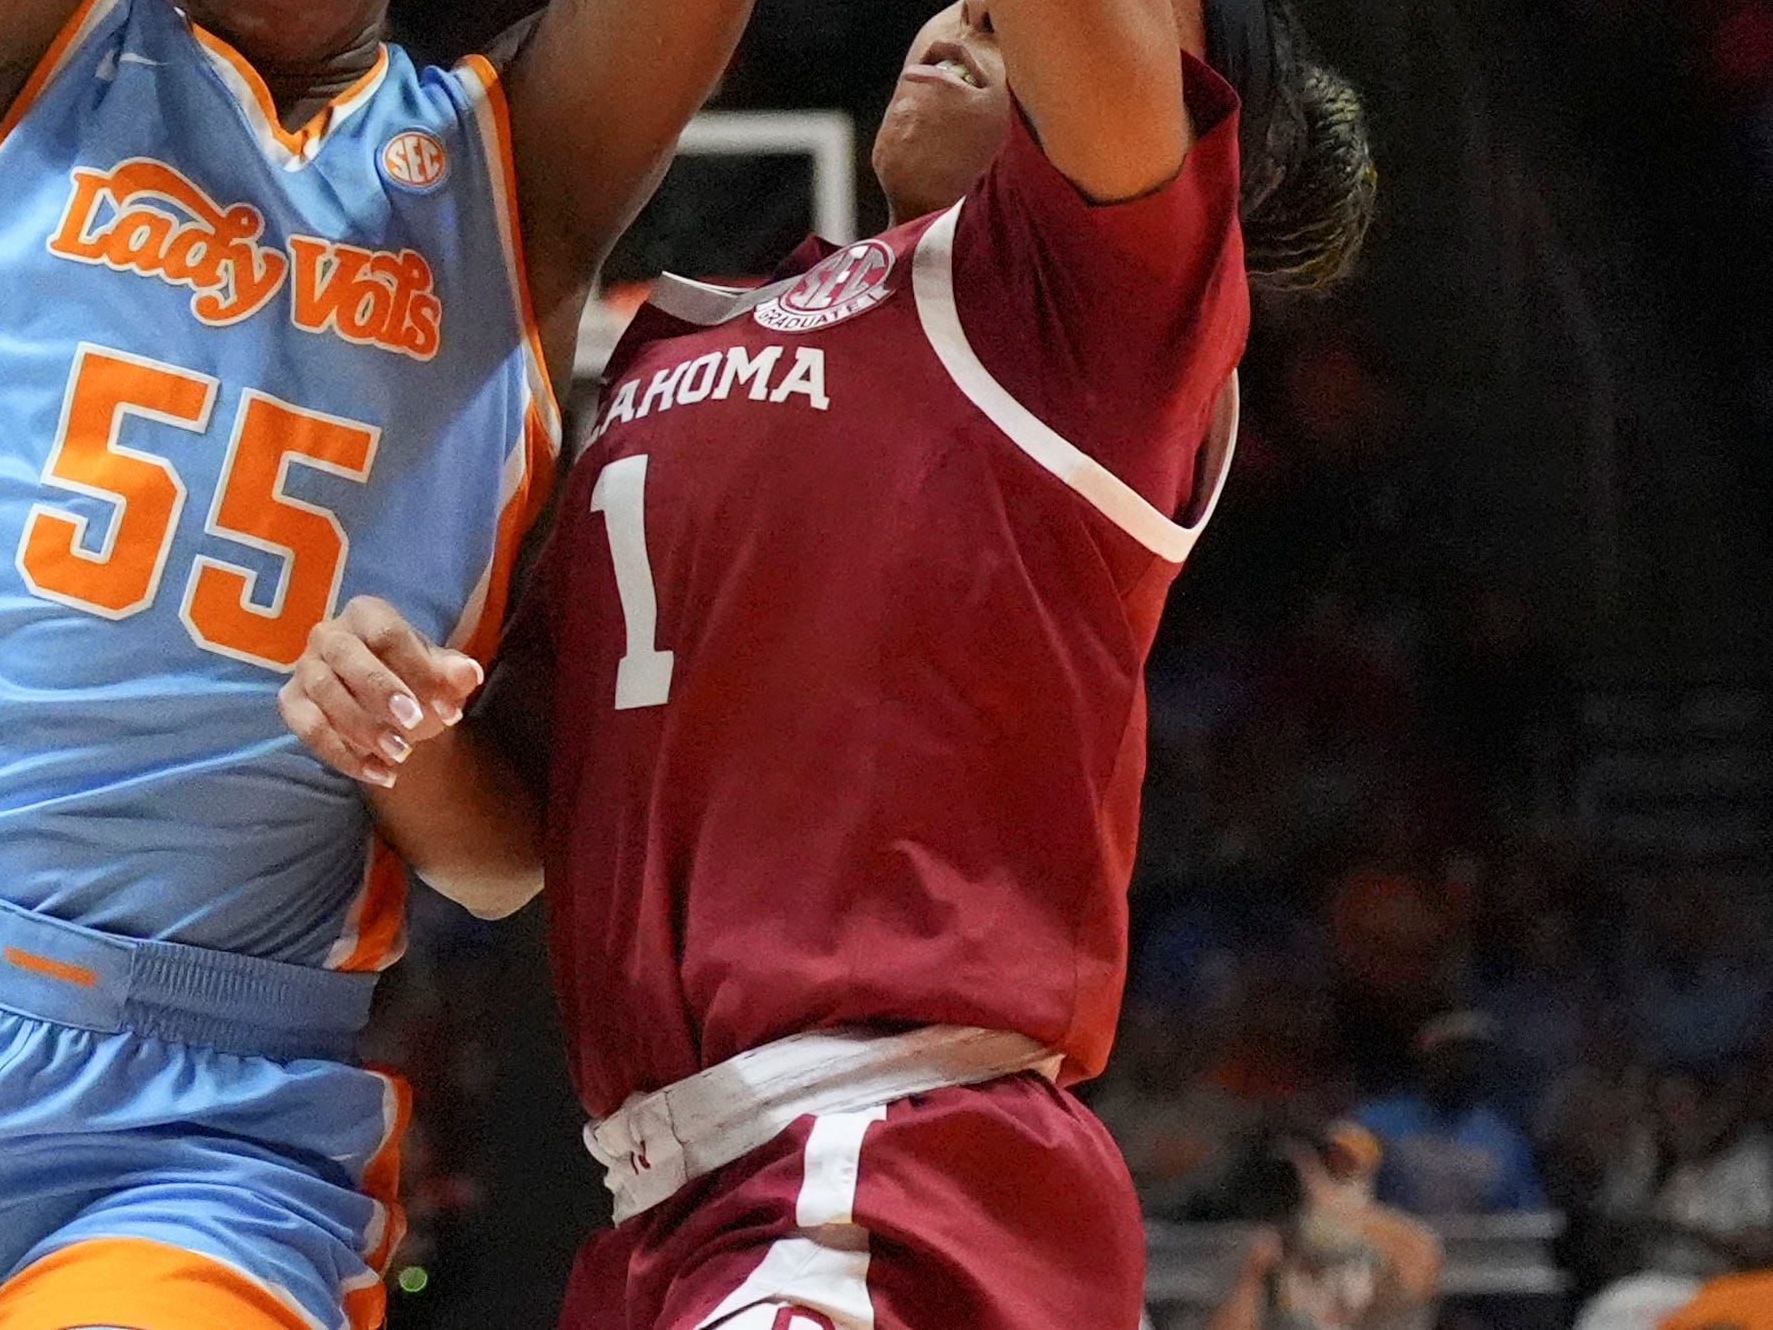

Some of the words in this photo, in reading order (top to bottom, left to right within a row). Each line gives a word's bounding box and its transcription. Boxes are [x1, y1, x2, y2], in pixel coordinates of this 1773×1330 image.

[386, 135, 442, 183] SEC
[46, 156, 288, 326] Lady
[288, 233, 442, 362] Vols
[789, 244, 886, 309] SEC
[757, 300, 861, 331] GRADUATE
[591, 346, 830, 442] AHOMA
[16, 341, 381, 673] 55
[590, 454, 674, 710] 1
